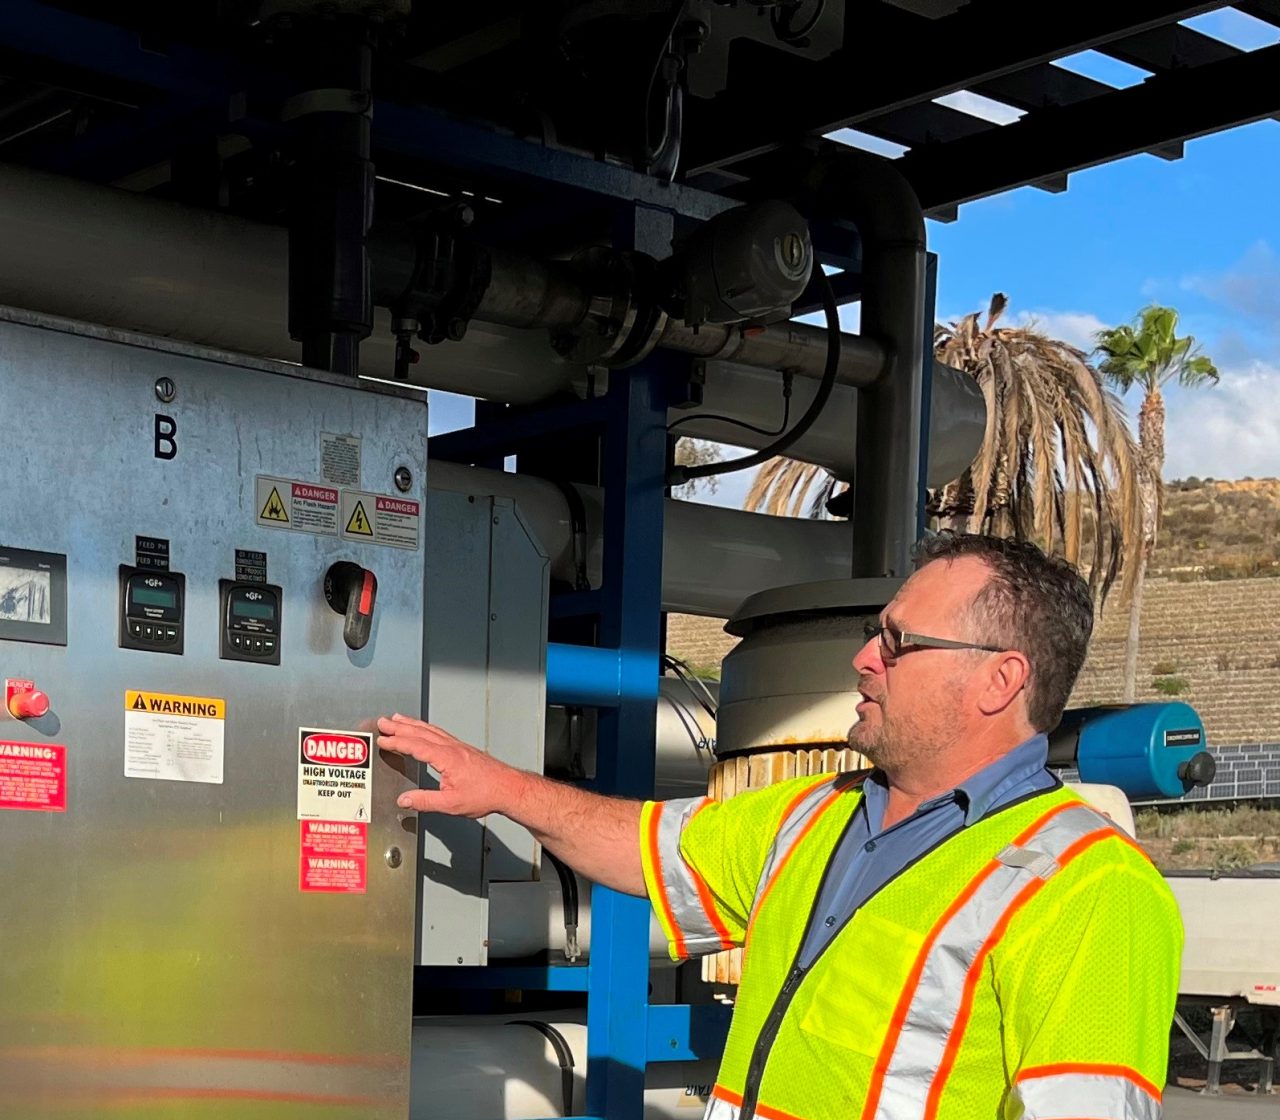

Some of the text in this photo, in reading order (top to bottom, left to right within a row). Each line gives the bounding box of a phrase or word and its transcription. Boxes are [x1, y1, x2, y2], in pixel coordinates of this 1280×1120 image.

[153, 414, 178, 460] B
[302, 488, 336, 501] DANGER
[385, 501, 417, 513] DANGER
[149, 698, 217, 717] WARNING
[306, 739, 364, 760] DANGER
[303, 766, 367, 780] HIGH VOLTAGE
[339, 781, 366, 790] PERSONNEL
[317, 789, 352, 799] KEEP OUT
[307, 823, 360, 835] WARNING:
[307, 858, 360, 870] WARNING:
